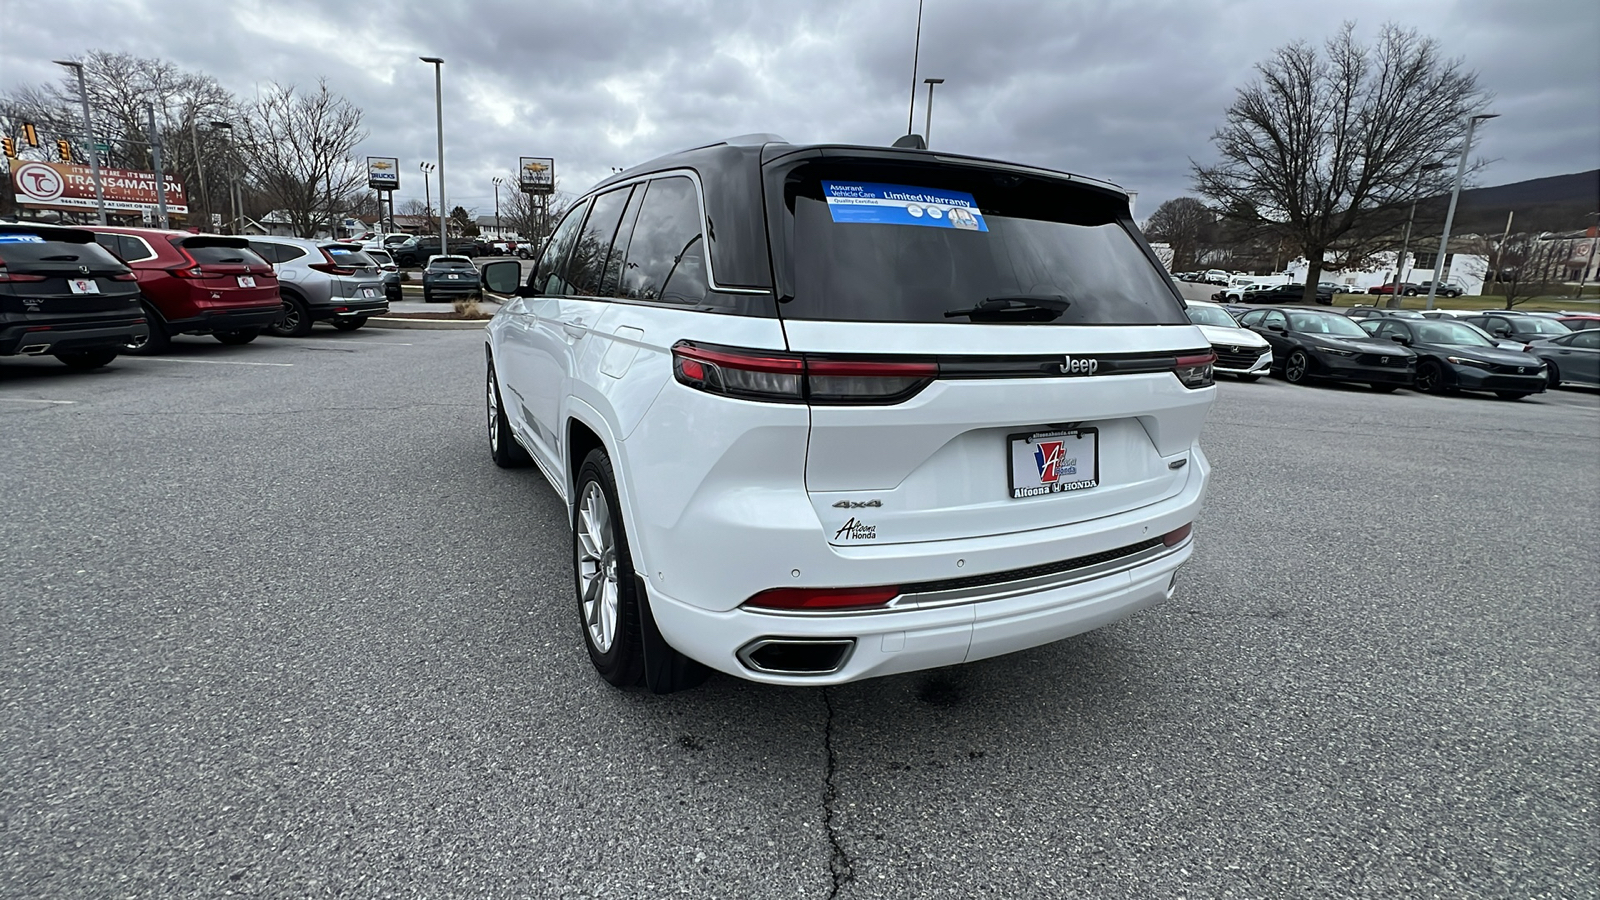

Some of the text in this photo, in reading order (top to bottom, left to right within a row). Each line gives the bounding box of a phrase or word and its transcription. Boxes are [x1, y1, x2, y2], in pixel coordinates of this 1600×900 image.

[139, 172, 155, 180] WHAT
[830, 184, 864, 192] Assurant
[830, 190, 858, 198] Vehicle
[883, 191, 971, 208] Limited Warranty
[1059, 355, 1098, 375] Jeep
[1014, 485, 1050, 498] Altoona
[1063, 479, 1097, 491] HONDA
[851, 532, 877, 540] Honda
